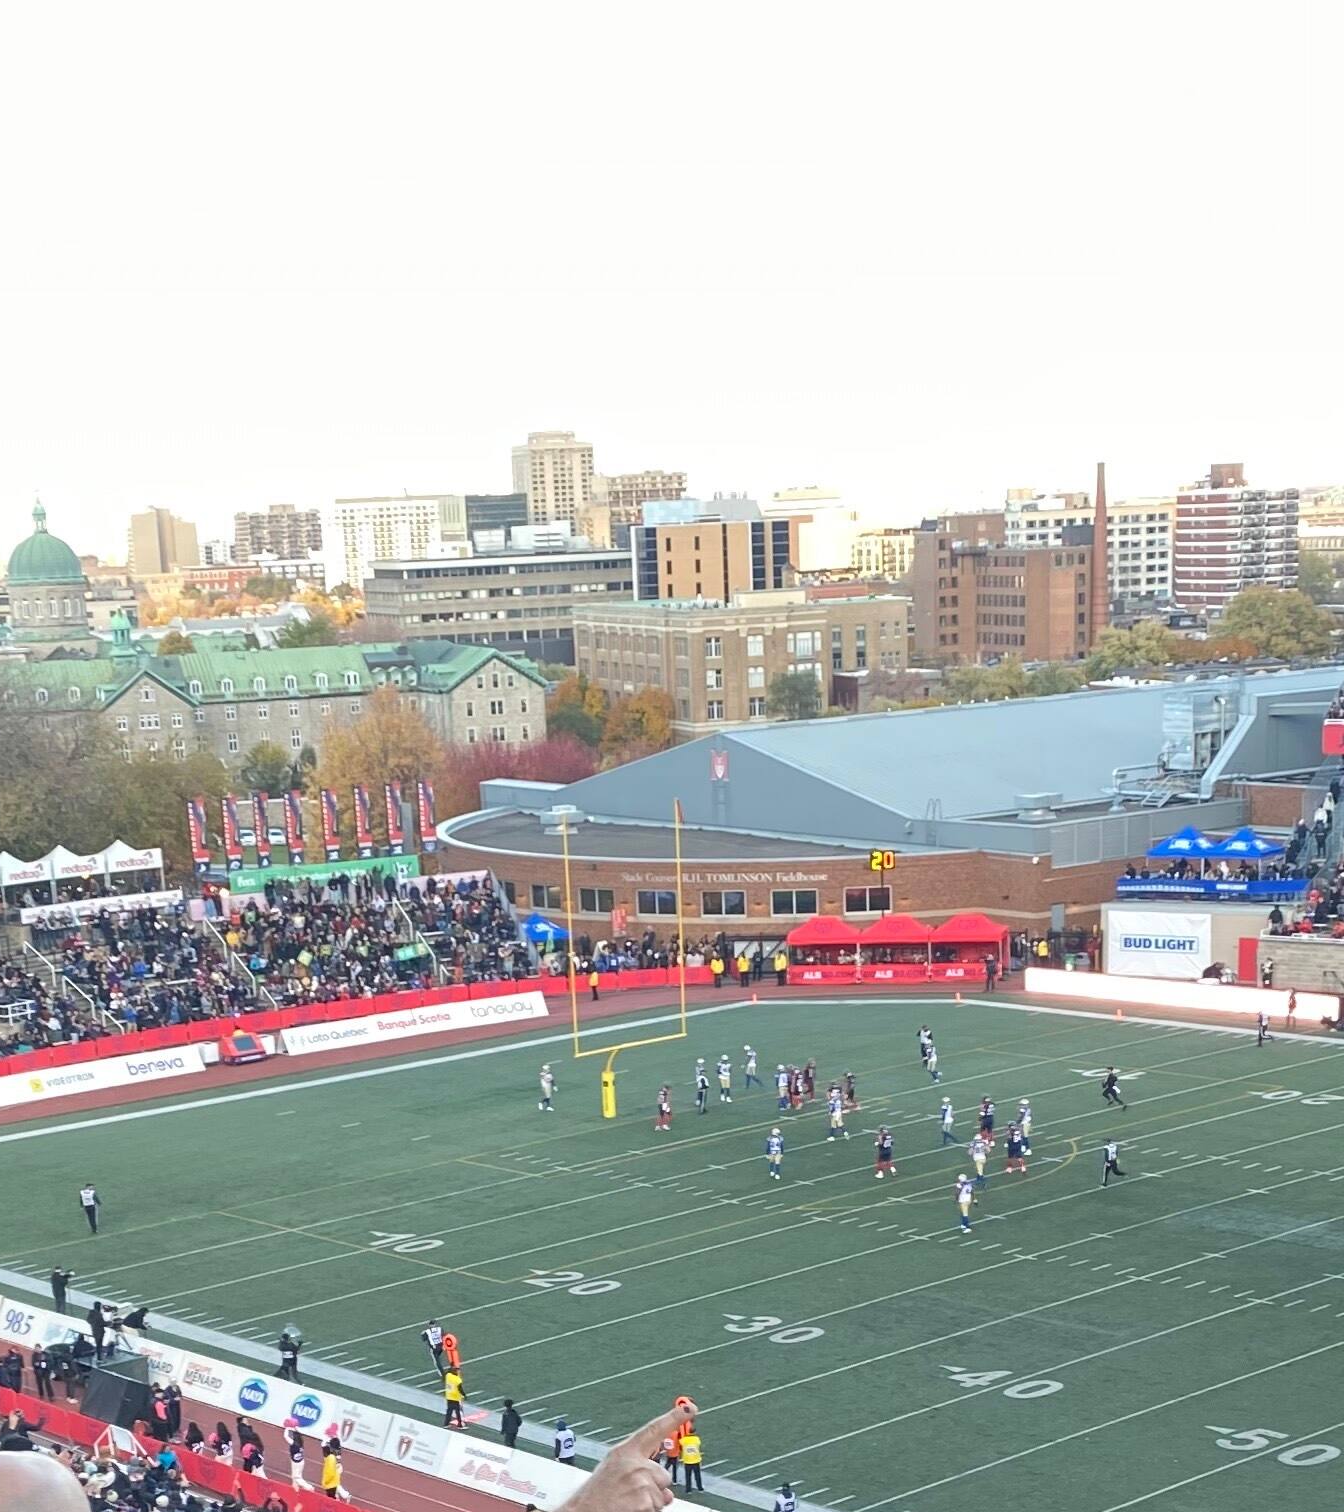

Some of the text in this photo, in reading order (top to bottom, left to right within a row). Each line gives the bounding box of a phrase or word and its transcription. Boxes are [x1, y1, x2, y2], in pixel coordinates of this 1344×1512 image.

[870, 851, 896, 871] 20
[706, 872, 773, 882] TOMLINSON
[776, 872, 828, 882] Fieldhouse
[1123, 937, 1196, 951] BUD LIGHT
[377, 1012, 451, 1031] Banque Scotia
[126, 1056, 184, 1076] beneva
[524, 1271, 622, 1296] 20
[724, 1314, 825, 1344] 30
[948, 1368, 1064, 1400] 40
[240, 1387, 266, 1404] NAYA
[292, 1403, 320, 1421] NAYA
[1214, 1427, 1342, 1467] 50
